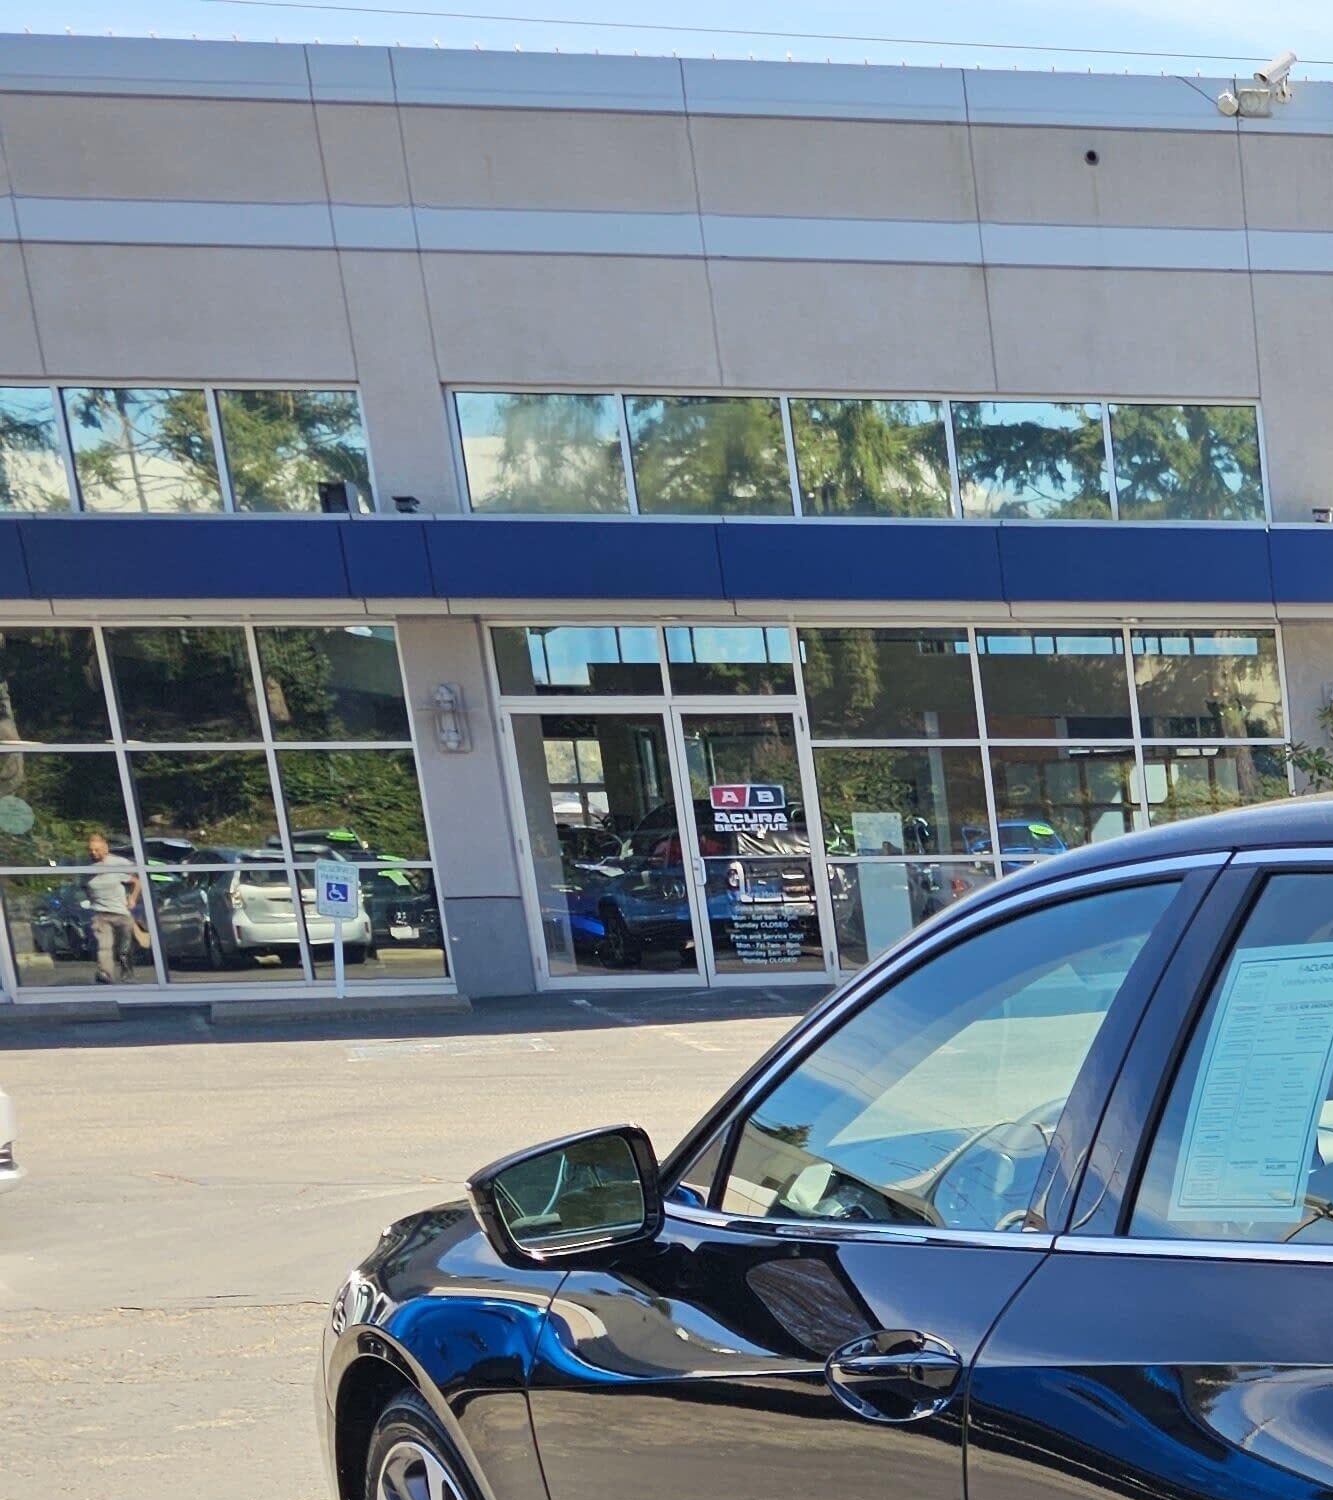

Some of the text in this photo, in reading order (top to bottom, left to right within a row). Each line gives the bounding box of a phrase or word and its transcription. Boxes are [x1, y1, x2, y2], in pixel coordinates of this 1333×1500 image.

[722, 791, 774, 803] A B
[714, 812, 787, 823] ACURA
[714, 824, 789, 832] BELLEVUE
